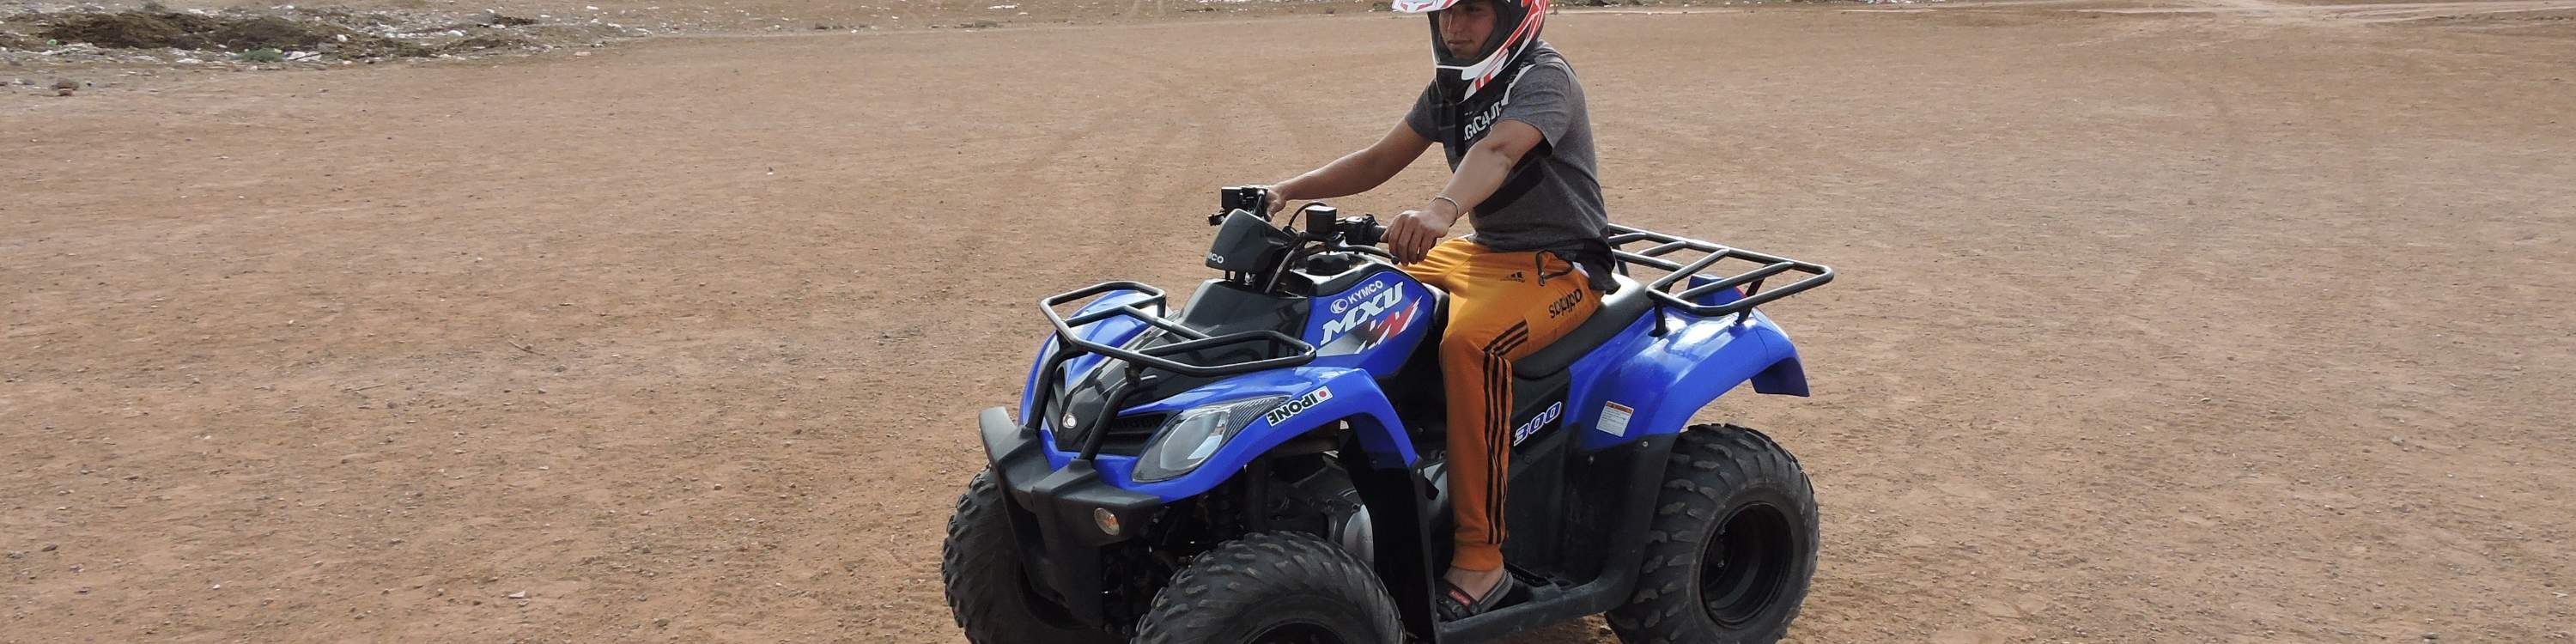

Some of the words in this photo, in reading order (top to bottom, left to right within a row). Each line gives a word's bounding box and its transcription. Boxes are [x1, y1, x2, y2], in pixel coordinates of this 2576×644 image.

[1348, 280, 1383, 304] KYMCO
[1320, 281, 1404, 345] MXU
[1267, 392, 1317, 425] IPONE
[1514, 401, 1562, 447] 300
